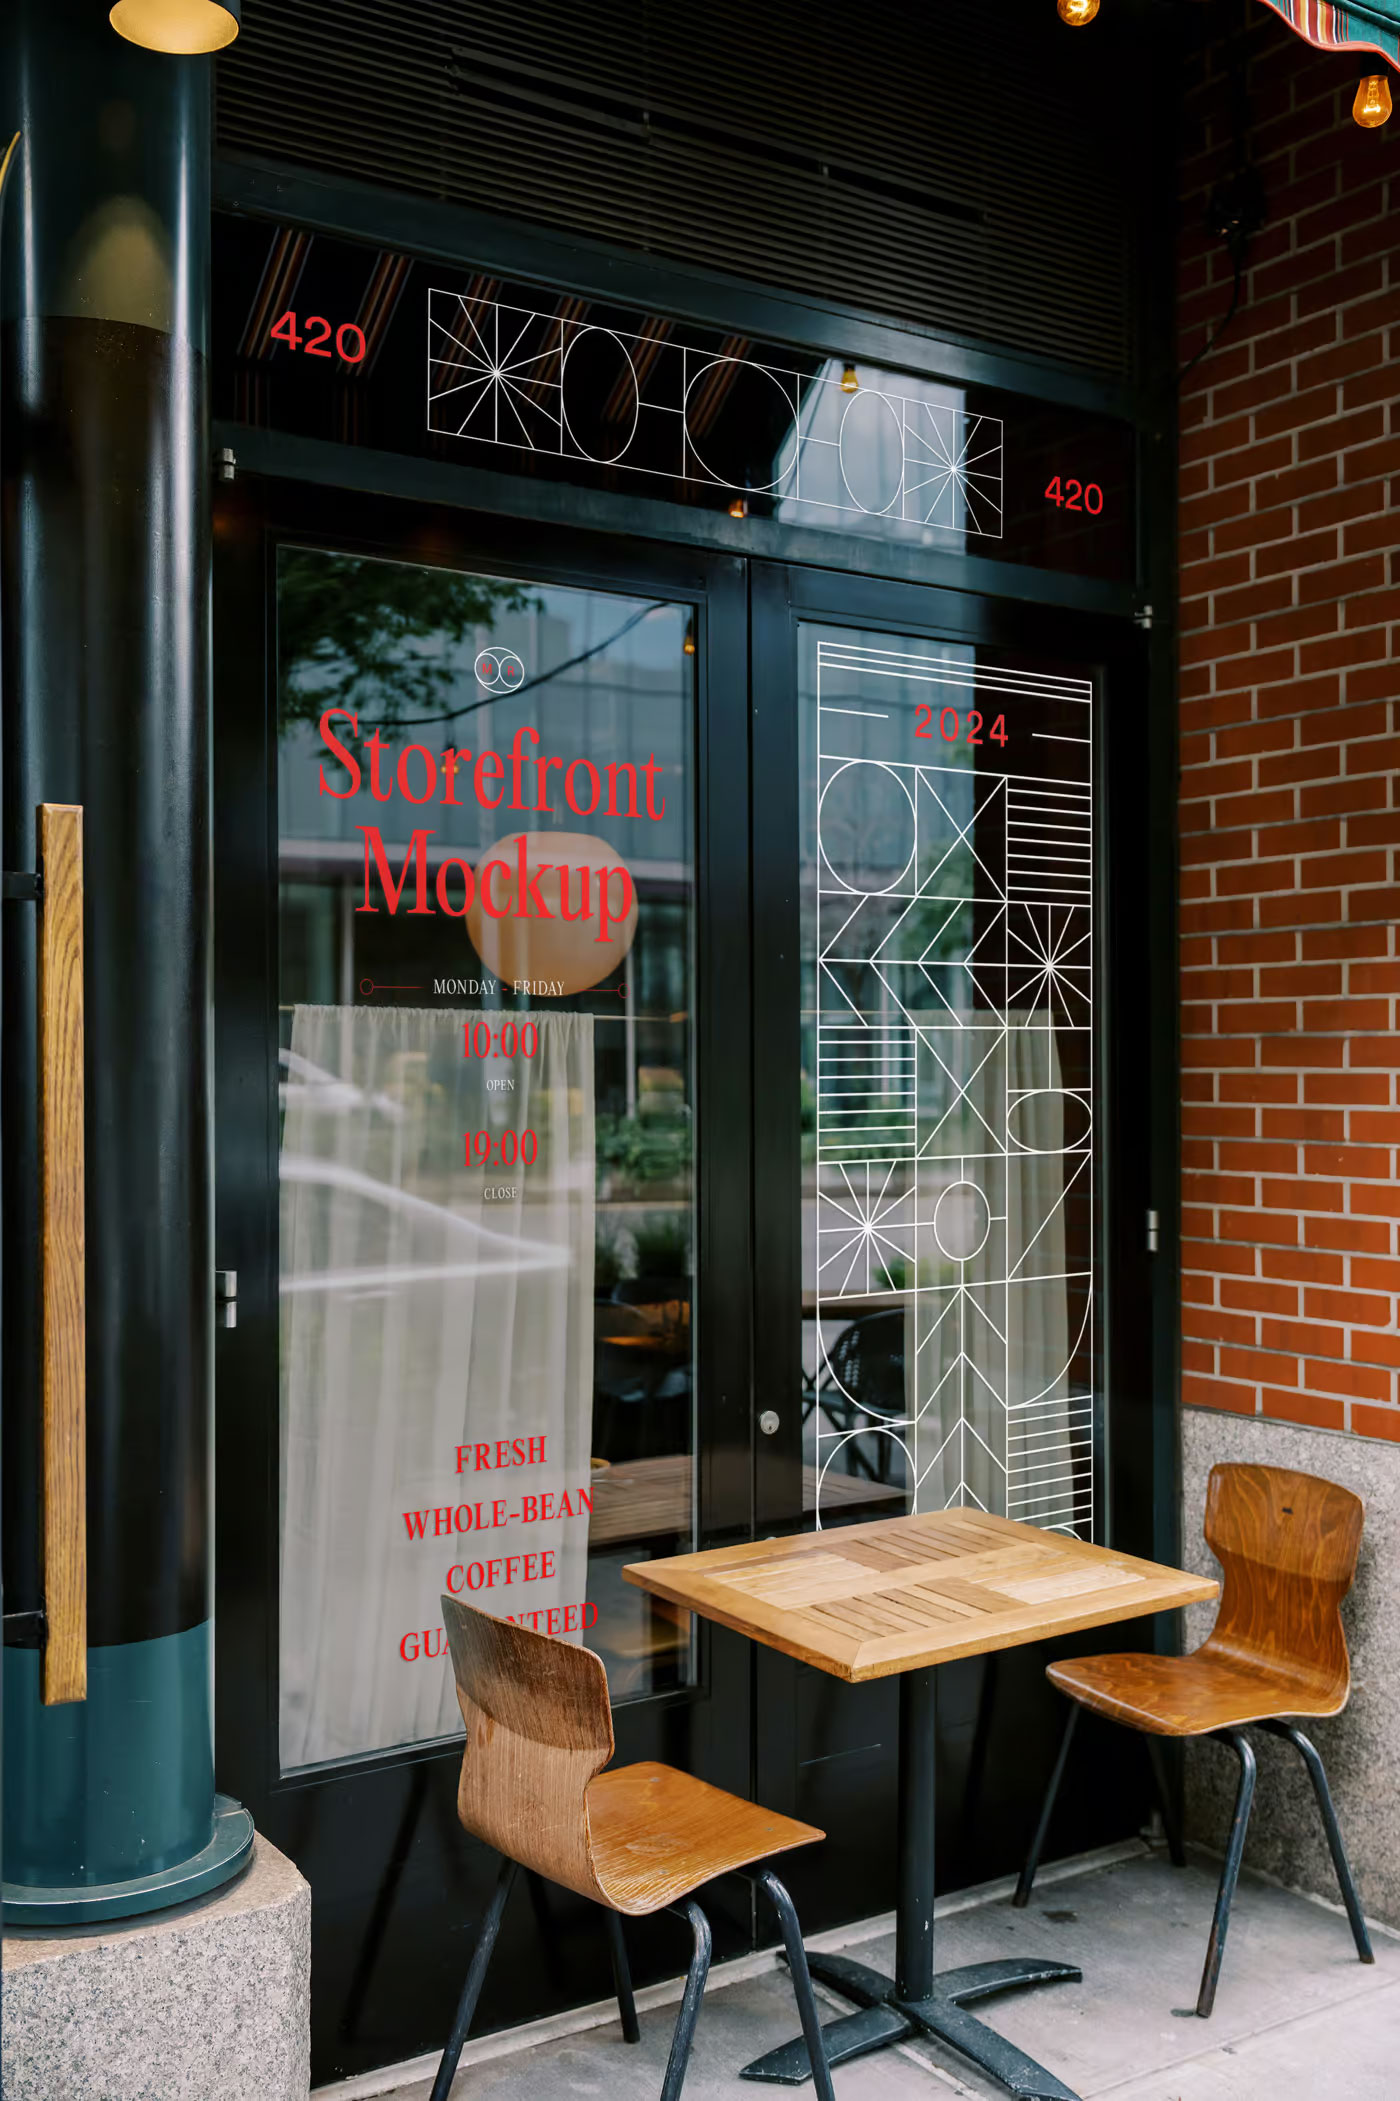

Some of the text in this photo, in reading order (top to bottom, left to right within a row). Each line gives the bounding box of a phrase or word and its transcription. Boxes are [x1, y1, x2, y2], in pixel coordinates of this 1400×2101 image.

[270, 311, 367, 364] 420
[1044, 475, 1104, 515] 420
[914, 703, 1009, 748] 2024
[319, 708, 666, 822] Storefront
[355, 825, 633, 943] Mockup
[433, 979, 497, 996] MONDAY
[513, 980, 565, 996] FRIDAY
[462, 1021, 539, 1059] 10:00
[486, 1079, 515, 1091] OPEN
[462, 1128, 538, 1167] 19:00
[484, 1187, 518, 1200] CLOSE
[454, 1435, 548, 1474] FRESH
[402, 1486, 596, 1541] WHOLE-BEAN
[446, 1549, 556, 1594] COFFEE
